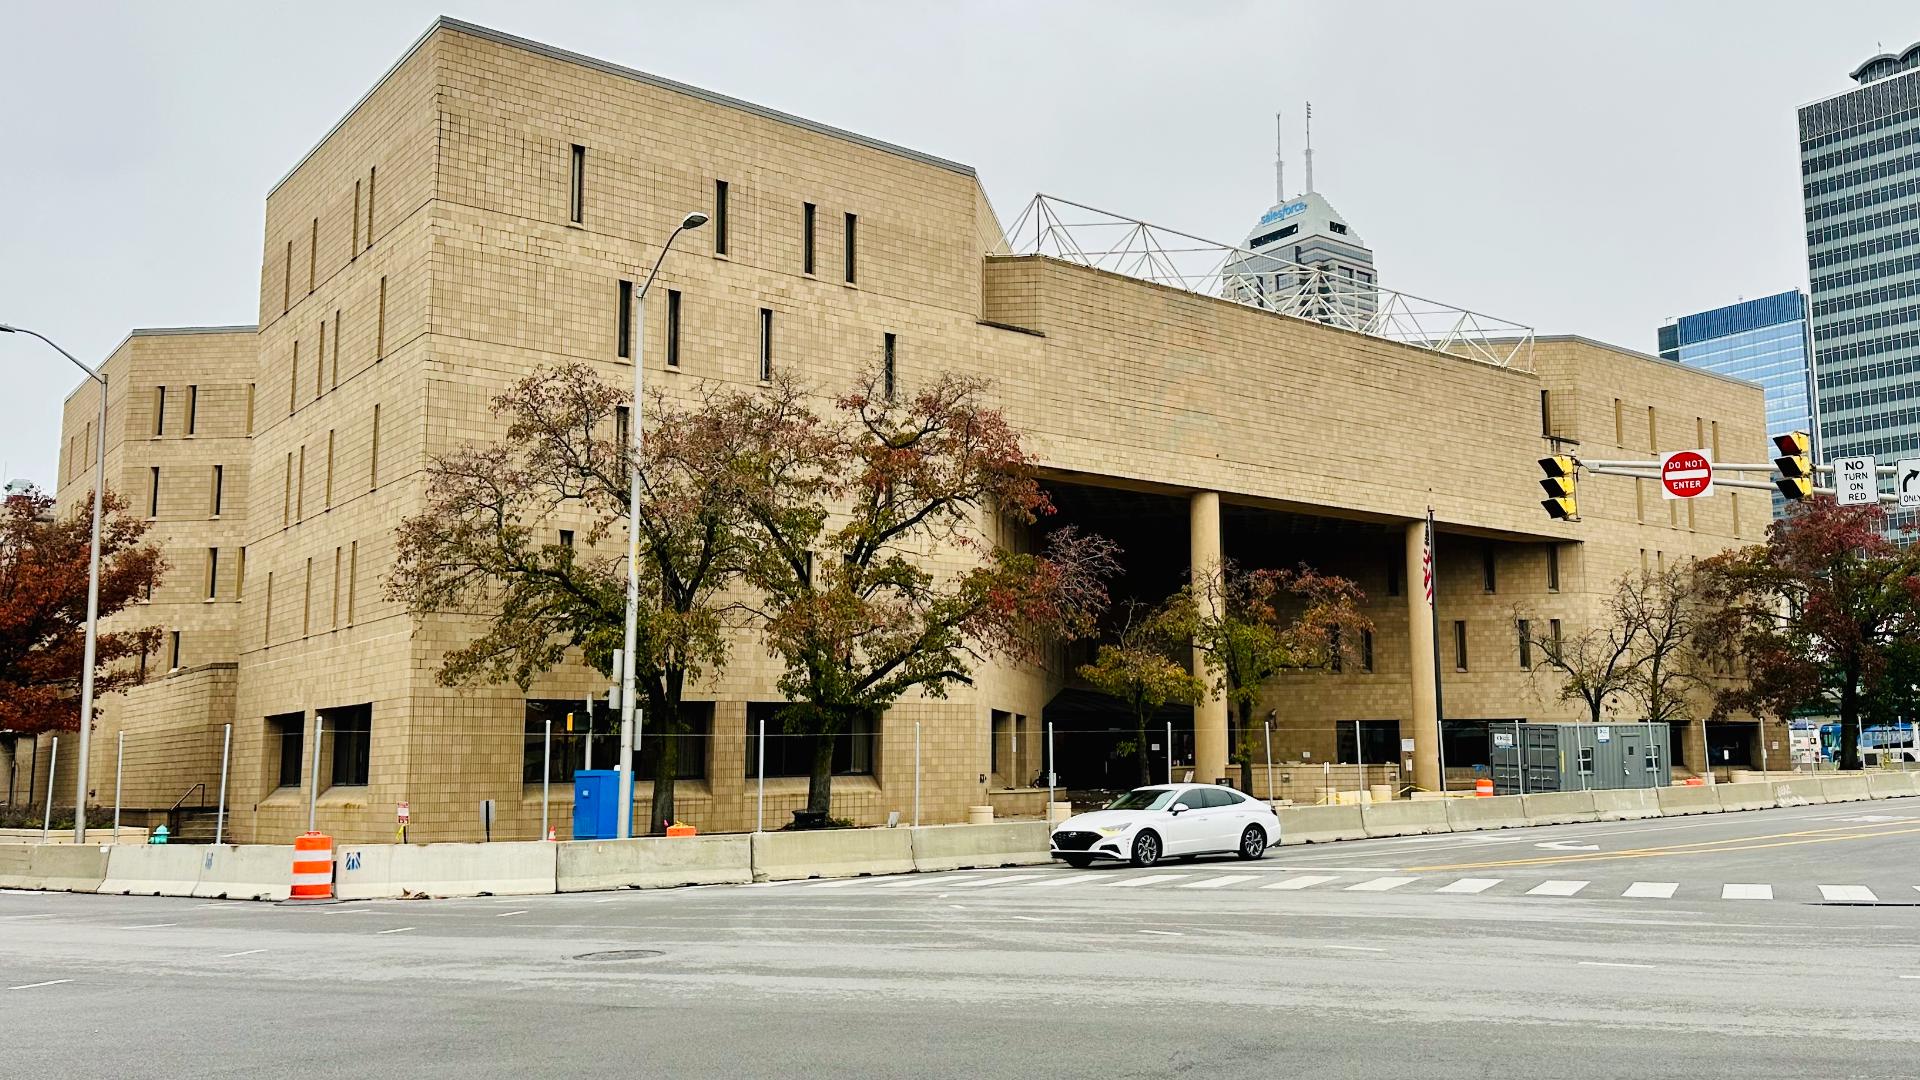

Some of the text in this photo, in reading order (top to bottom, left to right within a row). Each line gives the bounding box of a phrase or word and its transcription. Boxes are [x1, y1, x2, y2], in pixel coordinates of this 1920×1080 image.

[1261, 202, 1305, 225] salesforce
[1668, 459, 1704, 470] DO NOT
[1845, 460, 1864, 471] NO
[1844, 472, 1868, 481] TURN
[1673, 480, 1702, 490] ENTER
[1849, 482, 1864, 491] ON
[1848, 492, 1867, 501] RED
